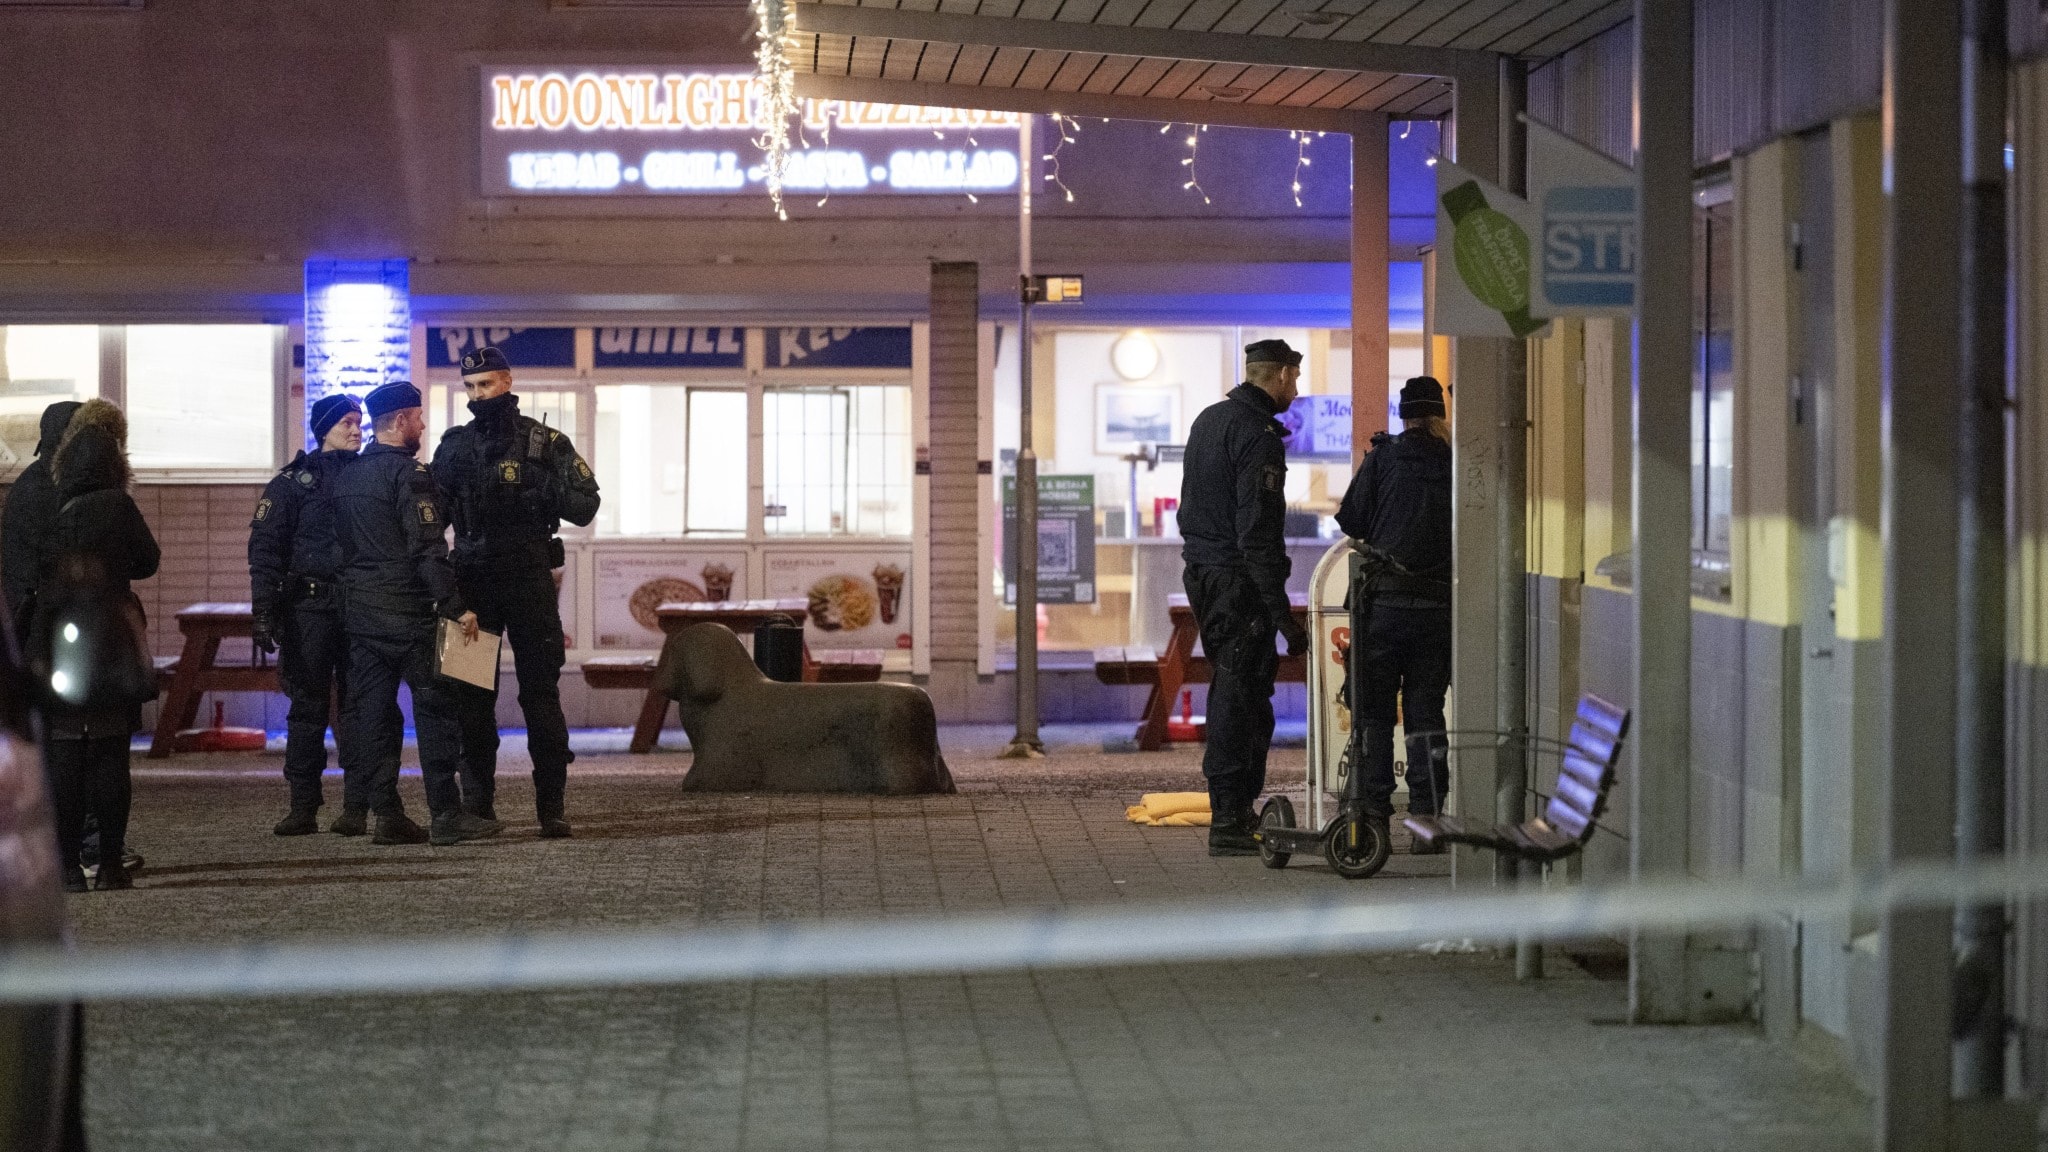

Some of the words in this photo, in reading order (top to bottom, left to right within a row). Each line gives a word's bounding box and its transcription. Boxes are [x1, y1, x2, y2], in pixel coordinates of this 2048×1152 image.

[493, 77, 773, 128] MOONLIGH
[510, 153, 620, 188] KEBAB
[643, 152, 744, 188] GRILL
[890, 152, 1018, 188] SALLAD
